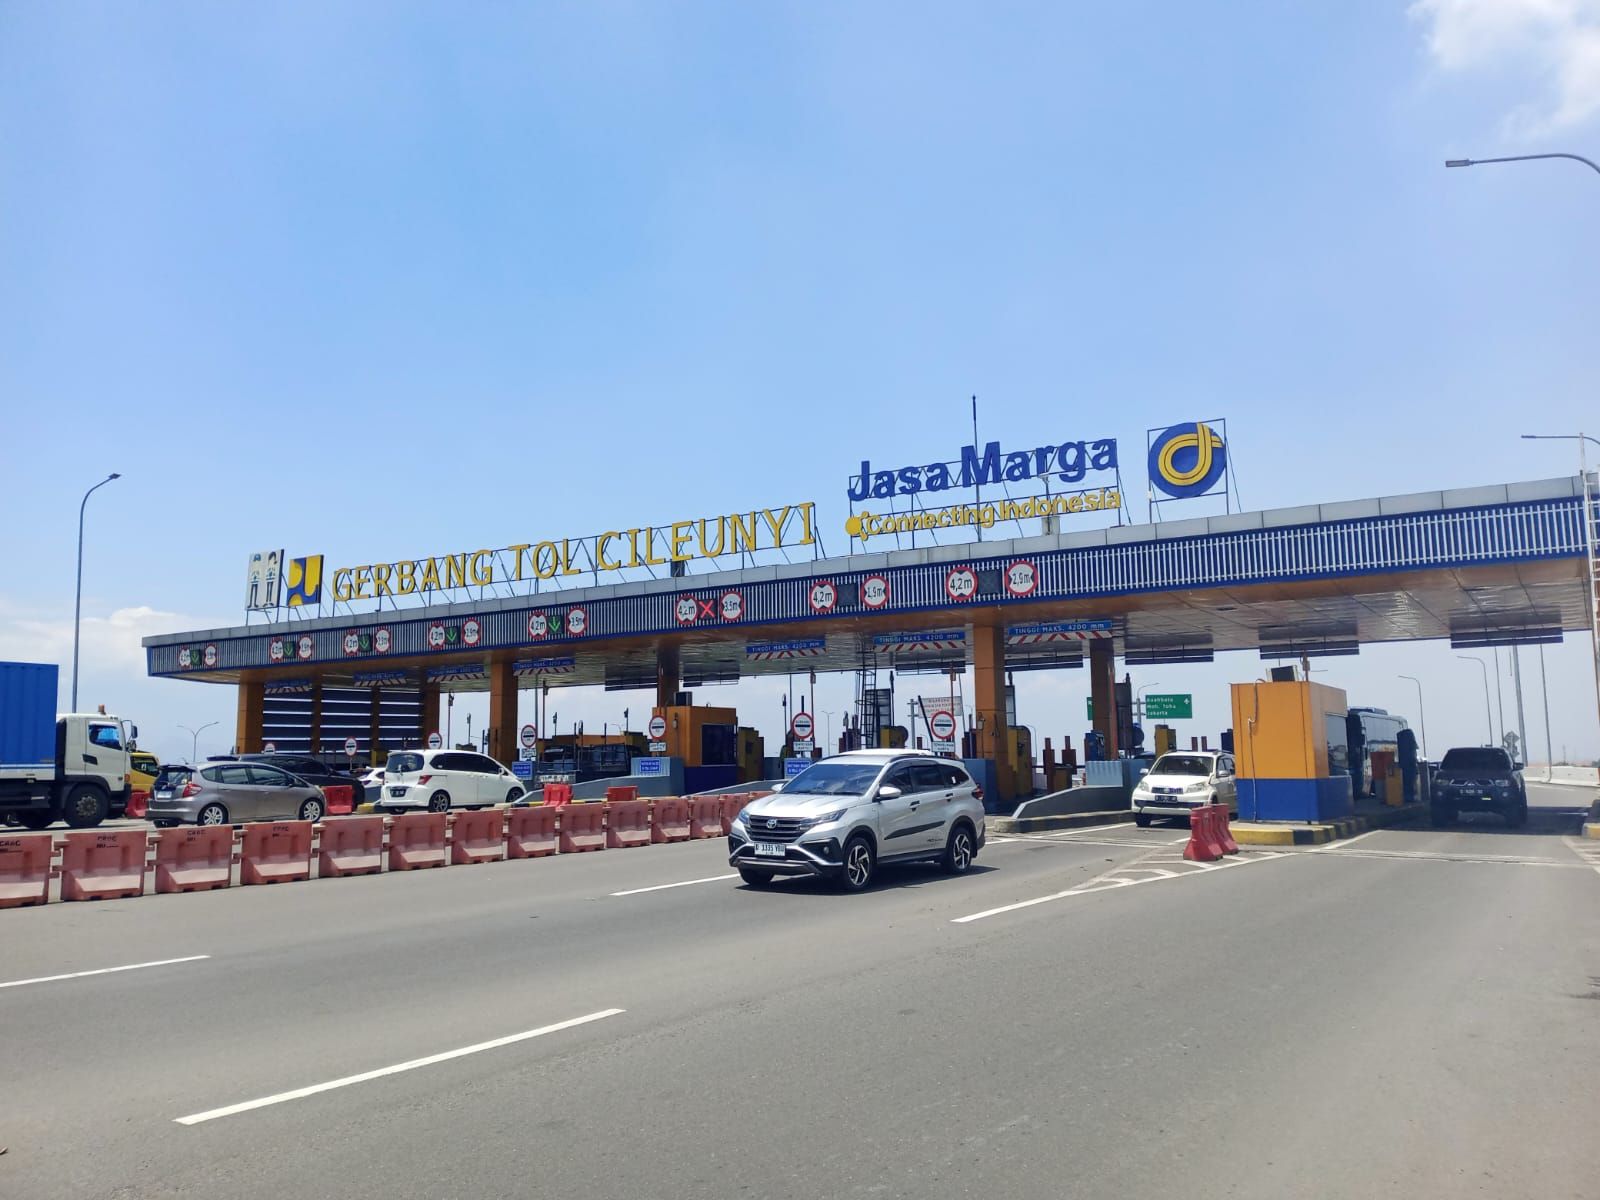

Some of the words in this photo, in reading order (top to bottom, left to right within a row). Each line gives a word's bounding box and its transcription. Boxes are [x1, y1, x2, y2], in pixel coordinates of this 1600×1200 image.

[847, 460, 949, 501] Jasa
[961, 438, 1117, 487] Marga
[866, 504, 996, 535] Connecting
[998, 488, 1122, 520] Indonesia
[331, 549, 494, 602] GERBANG
[507, 538, 582, 580] TOL
[597, 502, 816, 571] CILEUNYI
[949, 577, 973, 591] 4,2m
[1011, 571, 1031, 586] 2,9m
[812, 591, 833, 604] 4,2m
[1014, 627, 1040, 635] TINGGI
[1067, 623, 1087, 631] 4200
